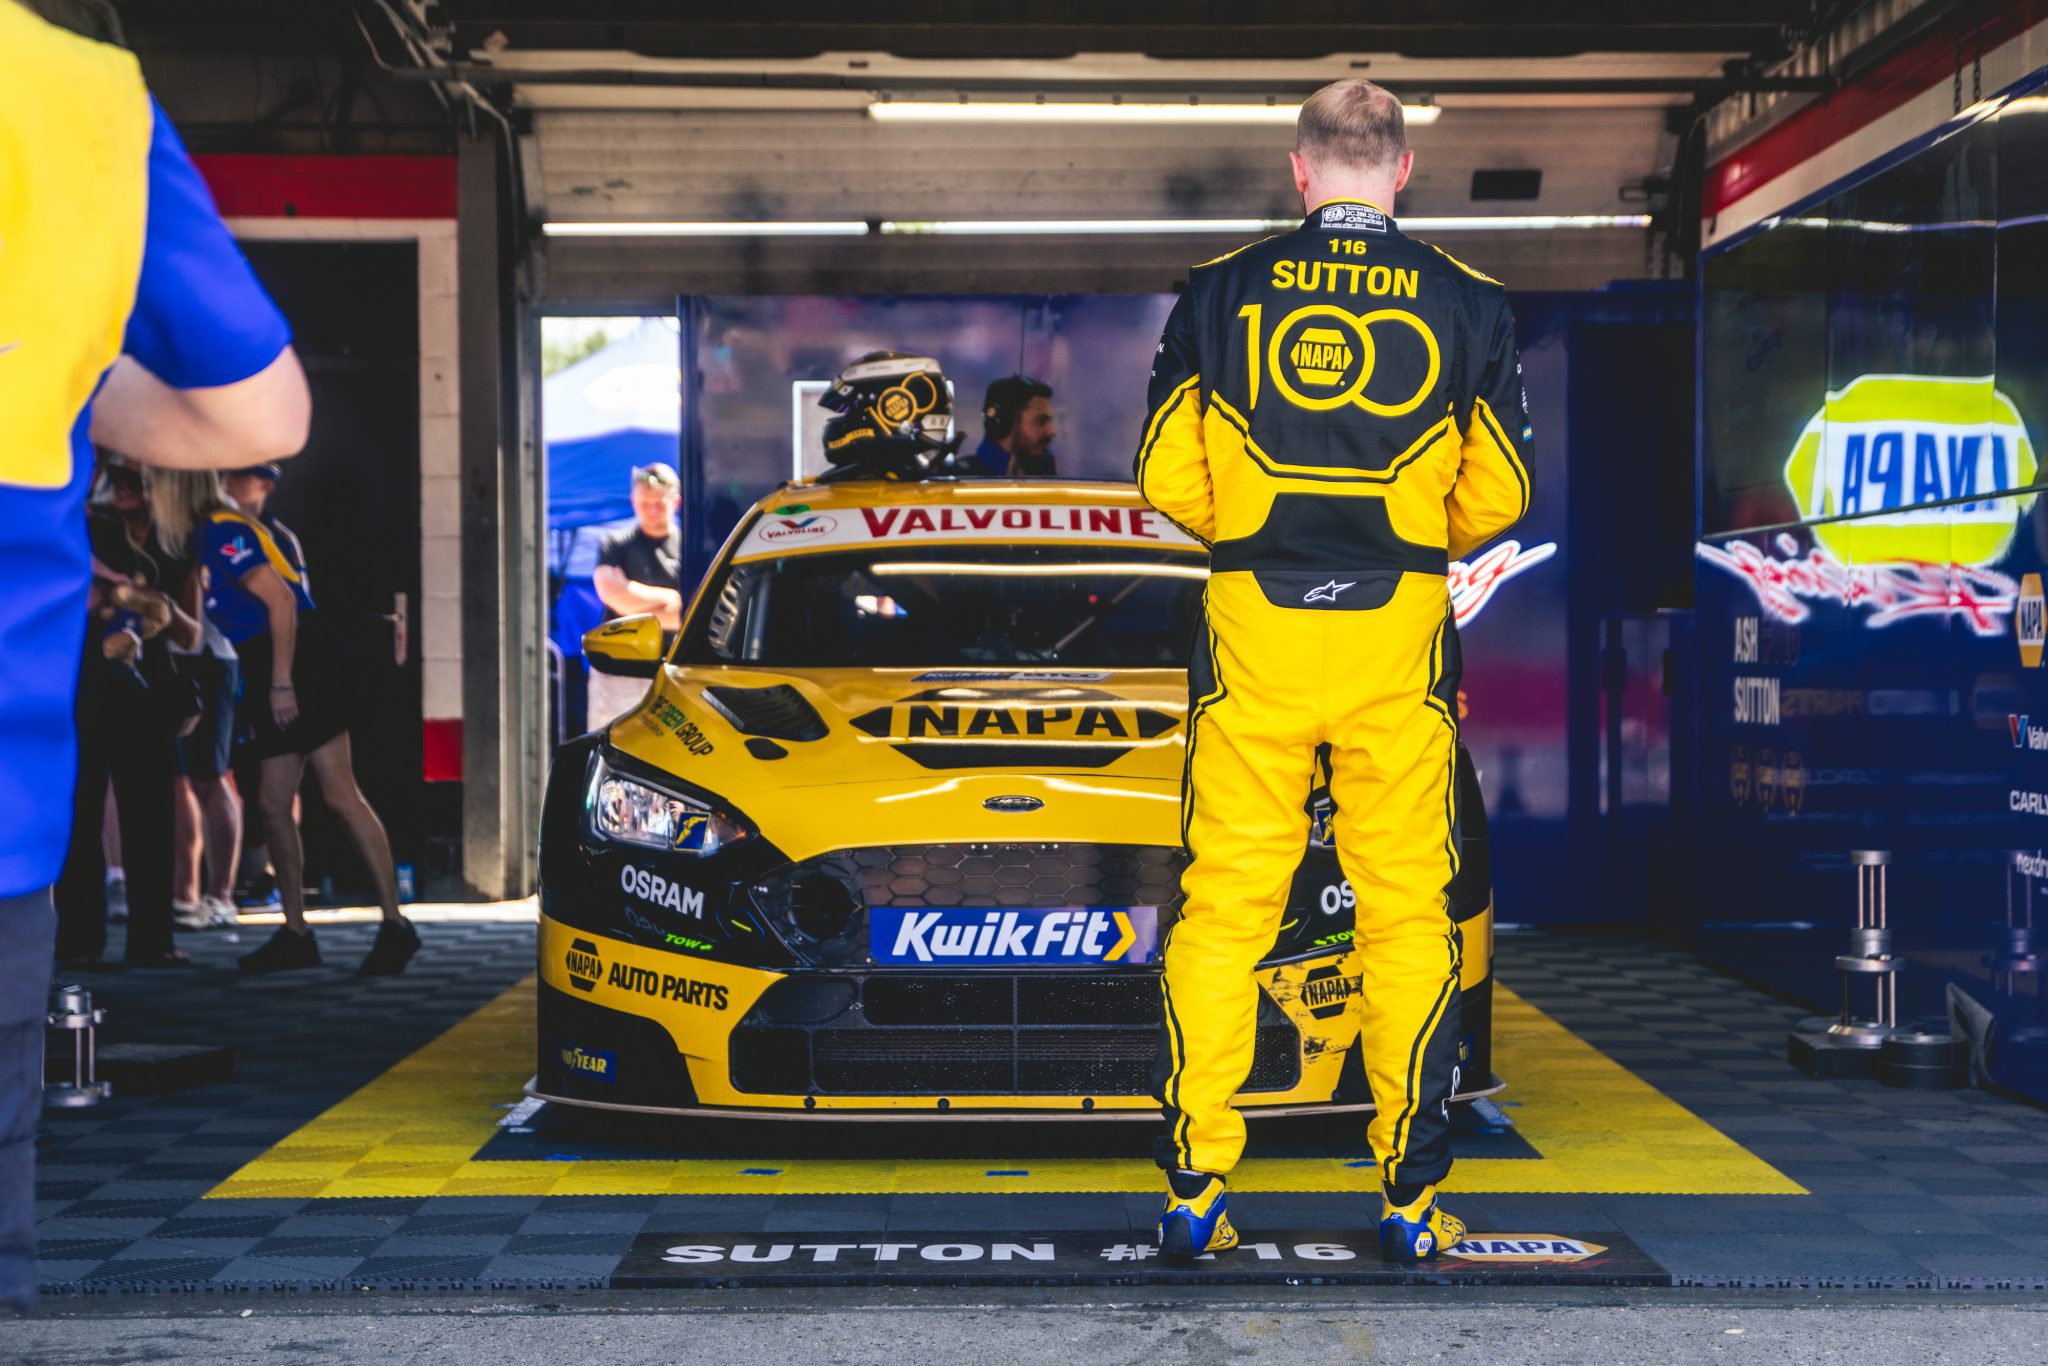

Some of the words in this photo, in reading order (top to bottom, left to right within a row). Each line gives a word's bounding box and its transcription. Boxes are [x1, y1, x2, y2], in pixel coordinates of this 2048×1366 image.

[1329, 239, 1367, 255] 116
[1271, 259, 1420, 299] SUTTON
[1299, 342, 1343, 370] NAPA
[767, 526, 826, 539] VALVOLINE
[860, 507, 1160, 538] VALVOLINE
[2020, 600, 2043, 640] NAPA
[1735, 617, 1758, 663] ASH
[1735, 676, 1780, 725] SUTTON
[908, 704, 1129, 738] NAPA
[674, 722, 714, 756] GROUP
[621, 864, 705, 920] OSRAM
[665, 933, 702, 949] TOW
[570, 951, 598, 980] NAPA
[608, 962, 659, 996] AUTO
[661, 974, 729, 1011] PARTS
[1309, 979, 1344, 1007] NAPA
[661, 1243, 1056, 1263] SUTTON
[1452, 1241, 1584, 1254] NAPA
